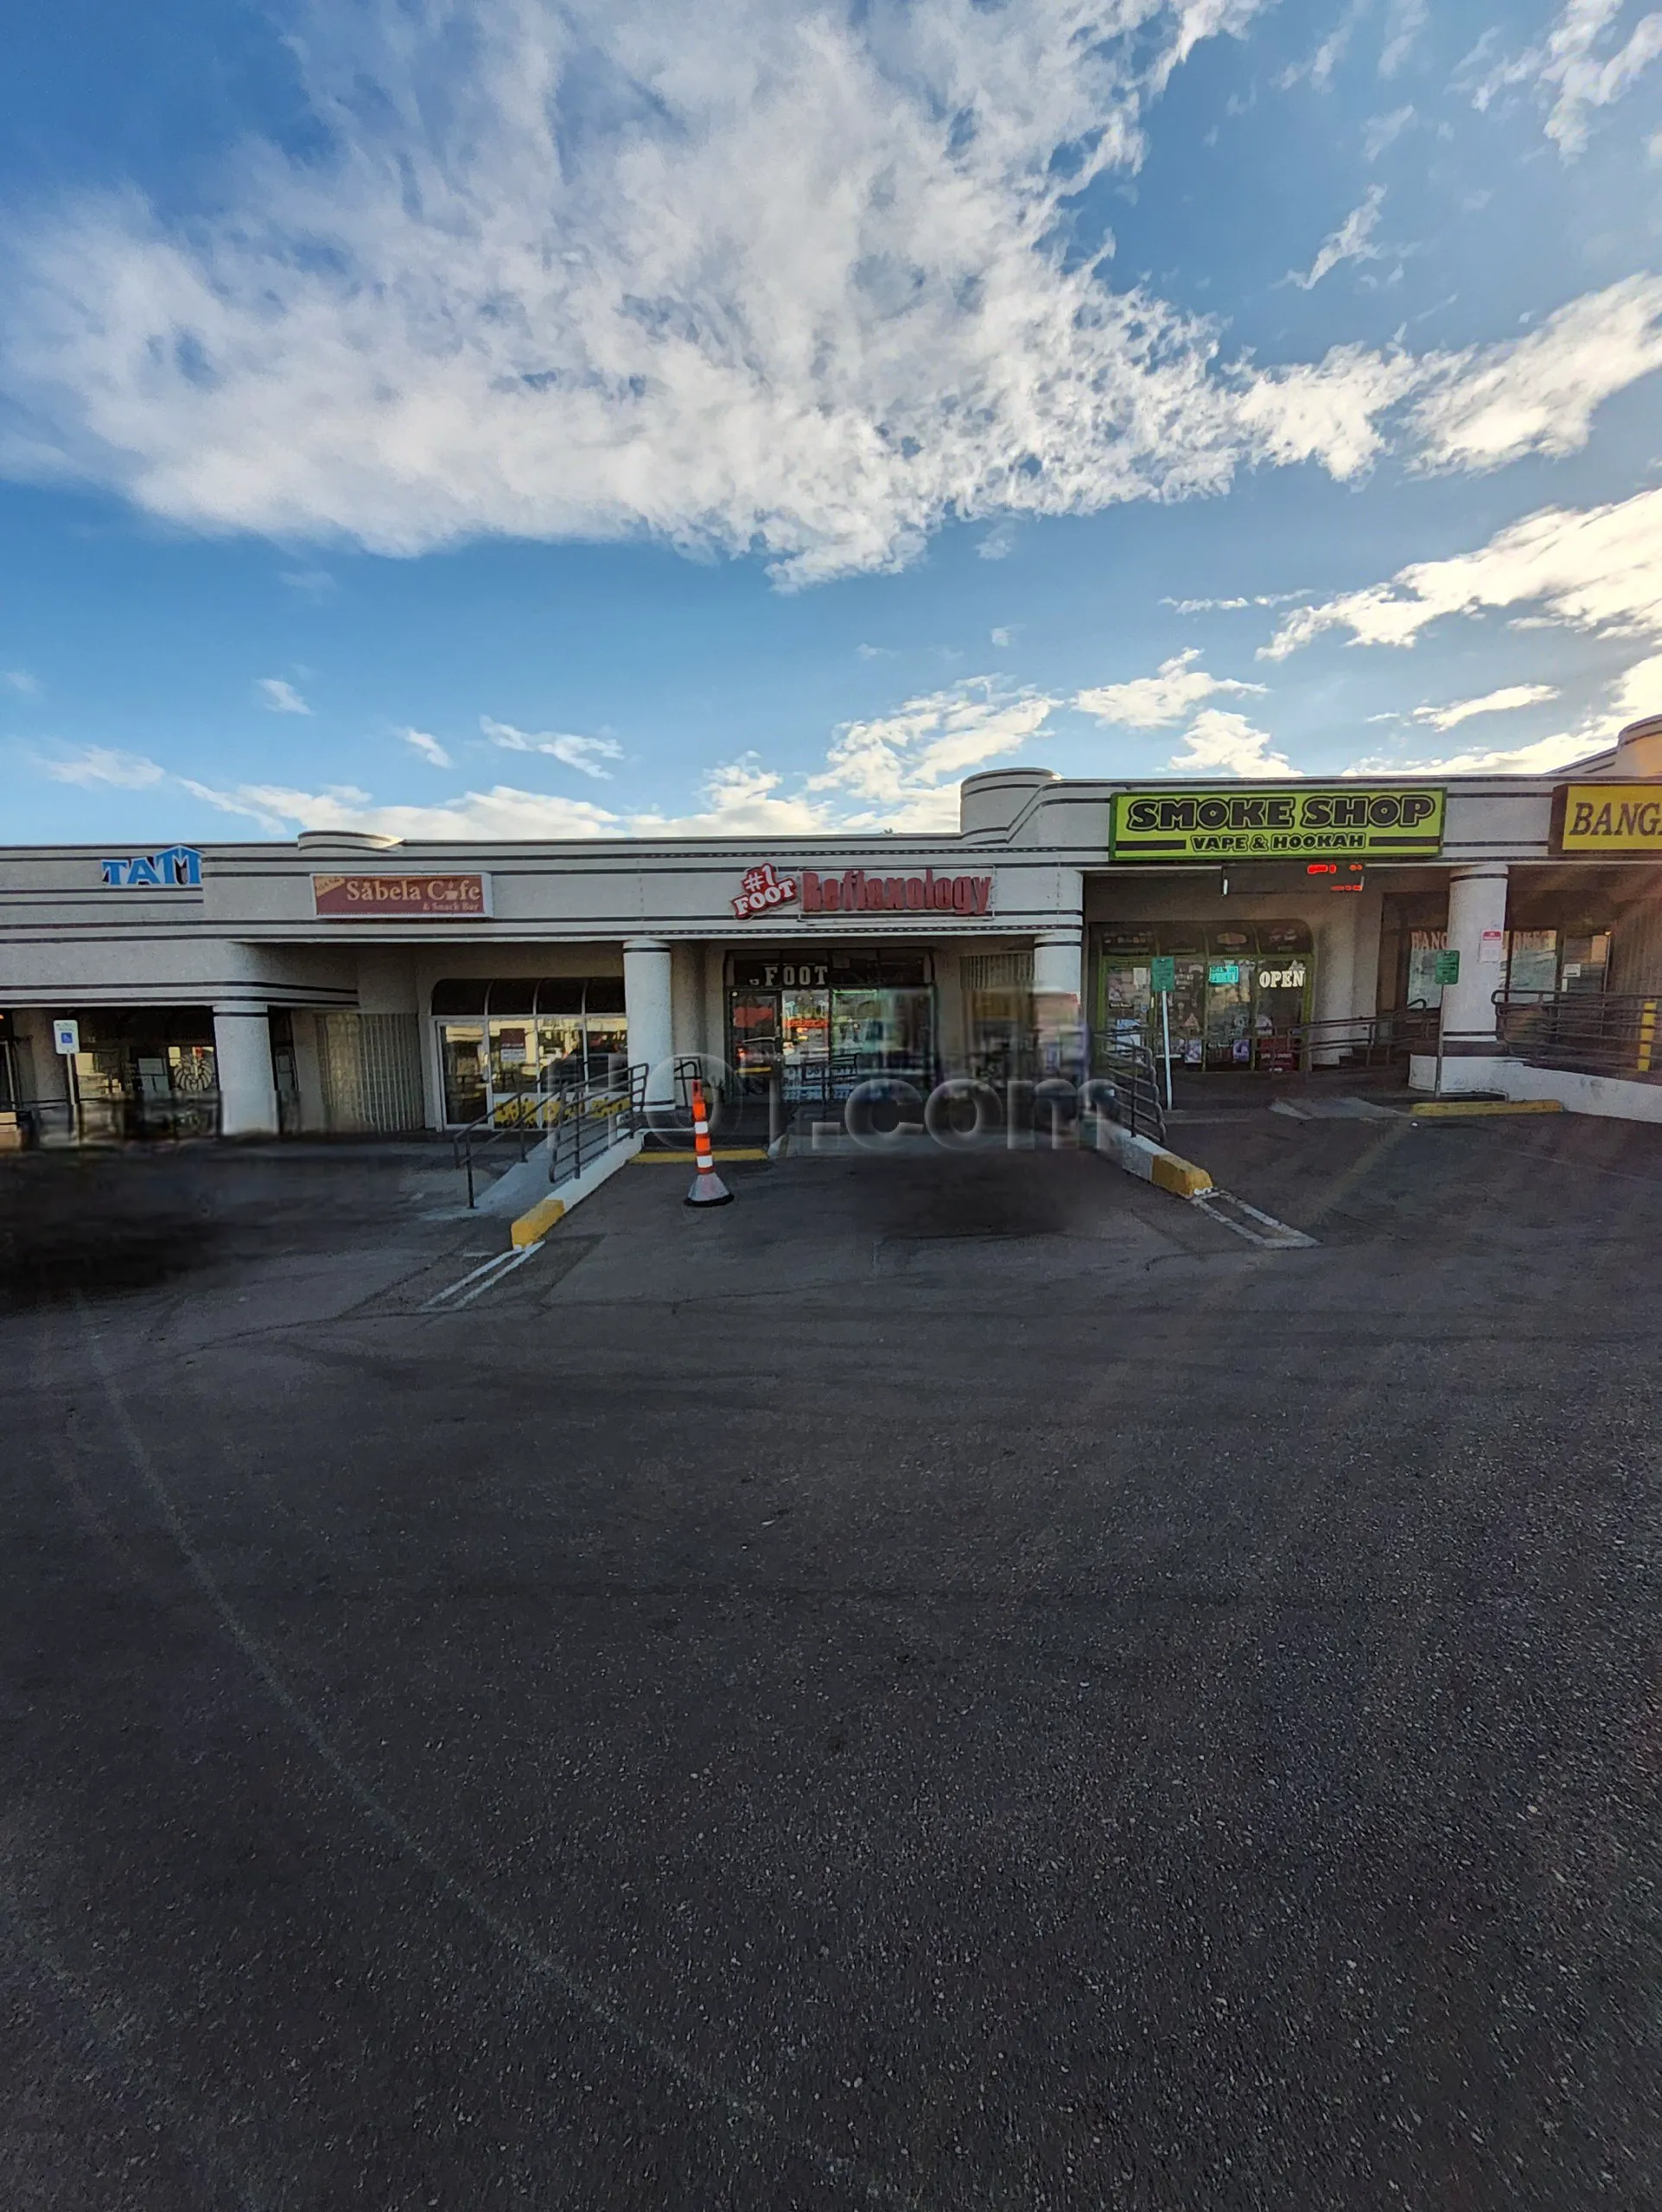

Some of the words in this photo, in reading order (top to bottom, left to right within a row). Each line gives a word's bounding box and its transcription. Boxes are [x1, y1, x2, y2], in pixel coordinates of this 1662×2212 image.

[1126, 797, 1295, 830] SMOKE
[1300, 794, 1436, 829] SHOP
[1569, 802, 1662, 836] BANG
[1192, 835, 1246, 852] VAPE
[1251, 835, 1269, 852] &
[1272, 833, 1366, 851] HOOKAH
[101, 844, 201, 885] TAM
[744, 865, 775, 893] #1
[427, 880, 481, 900] Cfe
[734, 880, 794, 916] FOOT
[802, 868, 991, 914] Reflexology
[765, 965, 828, 986] FOOT
[1259, 970, 1305, 988] OPEN
